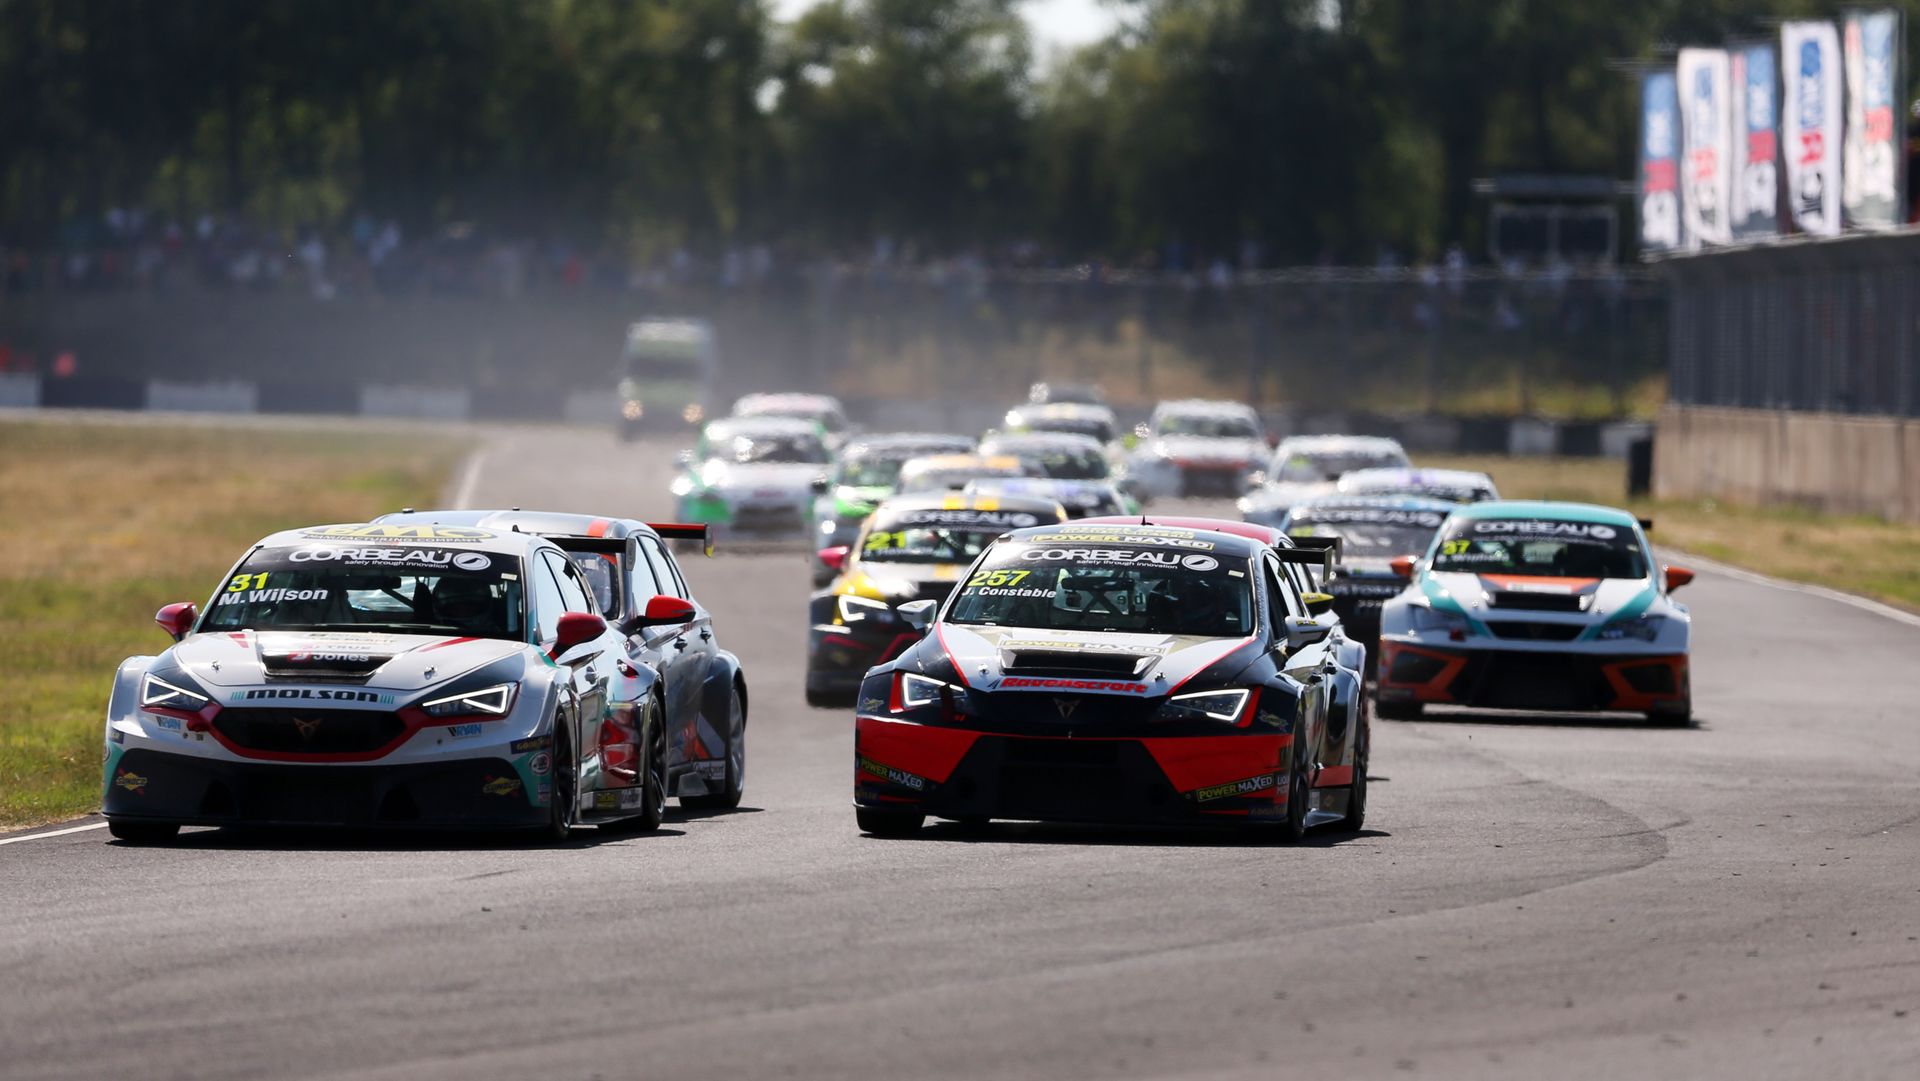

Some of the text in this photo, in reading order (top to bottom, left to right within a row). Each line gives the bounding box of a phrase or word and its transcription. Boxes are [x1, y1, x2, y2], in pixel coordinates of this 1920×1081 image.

[864, 530, 906, 551] 21
[1124, 537, 1211, 549] MAXED
[1442, 540, 1472, 555] 37
[289, 549, 452, 563] CORBEAU
[1021, 549, 1181, 564] CORBEAU
[406, 561, 449, 569] innovation
[1103, 560, 1135, 568] through
[227, 571, 270, 592] 31
[966, 570, 1031, 586] 257
[248, 588, 329, 603] Wilson
[962, 586, 1057, 599] J. Constable
[314, 652, 370, 662] Jones
[1001, 677, 1148, 694] Ravenscroft
[888, 769, 923, 789] MAXED
[1199, 776, 1273, 800] POWER MAXED
